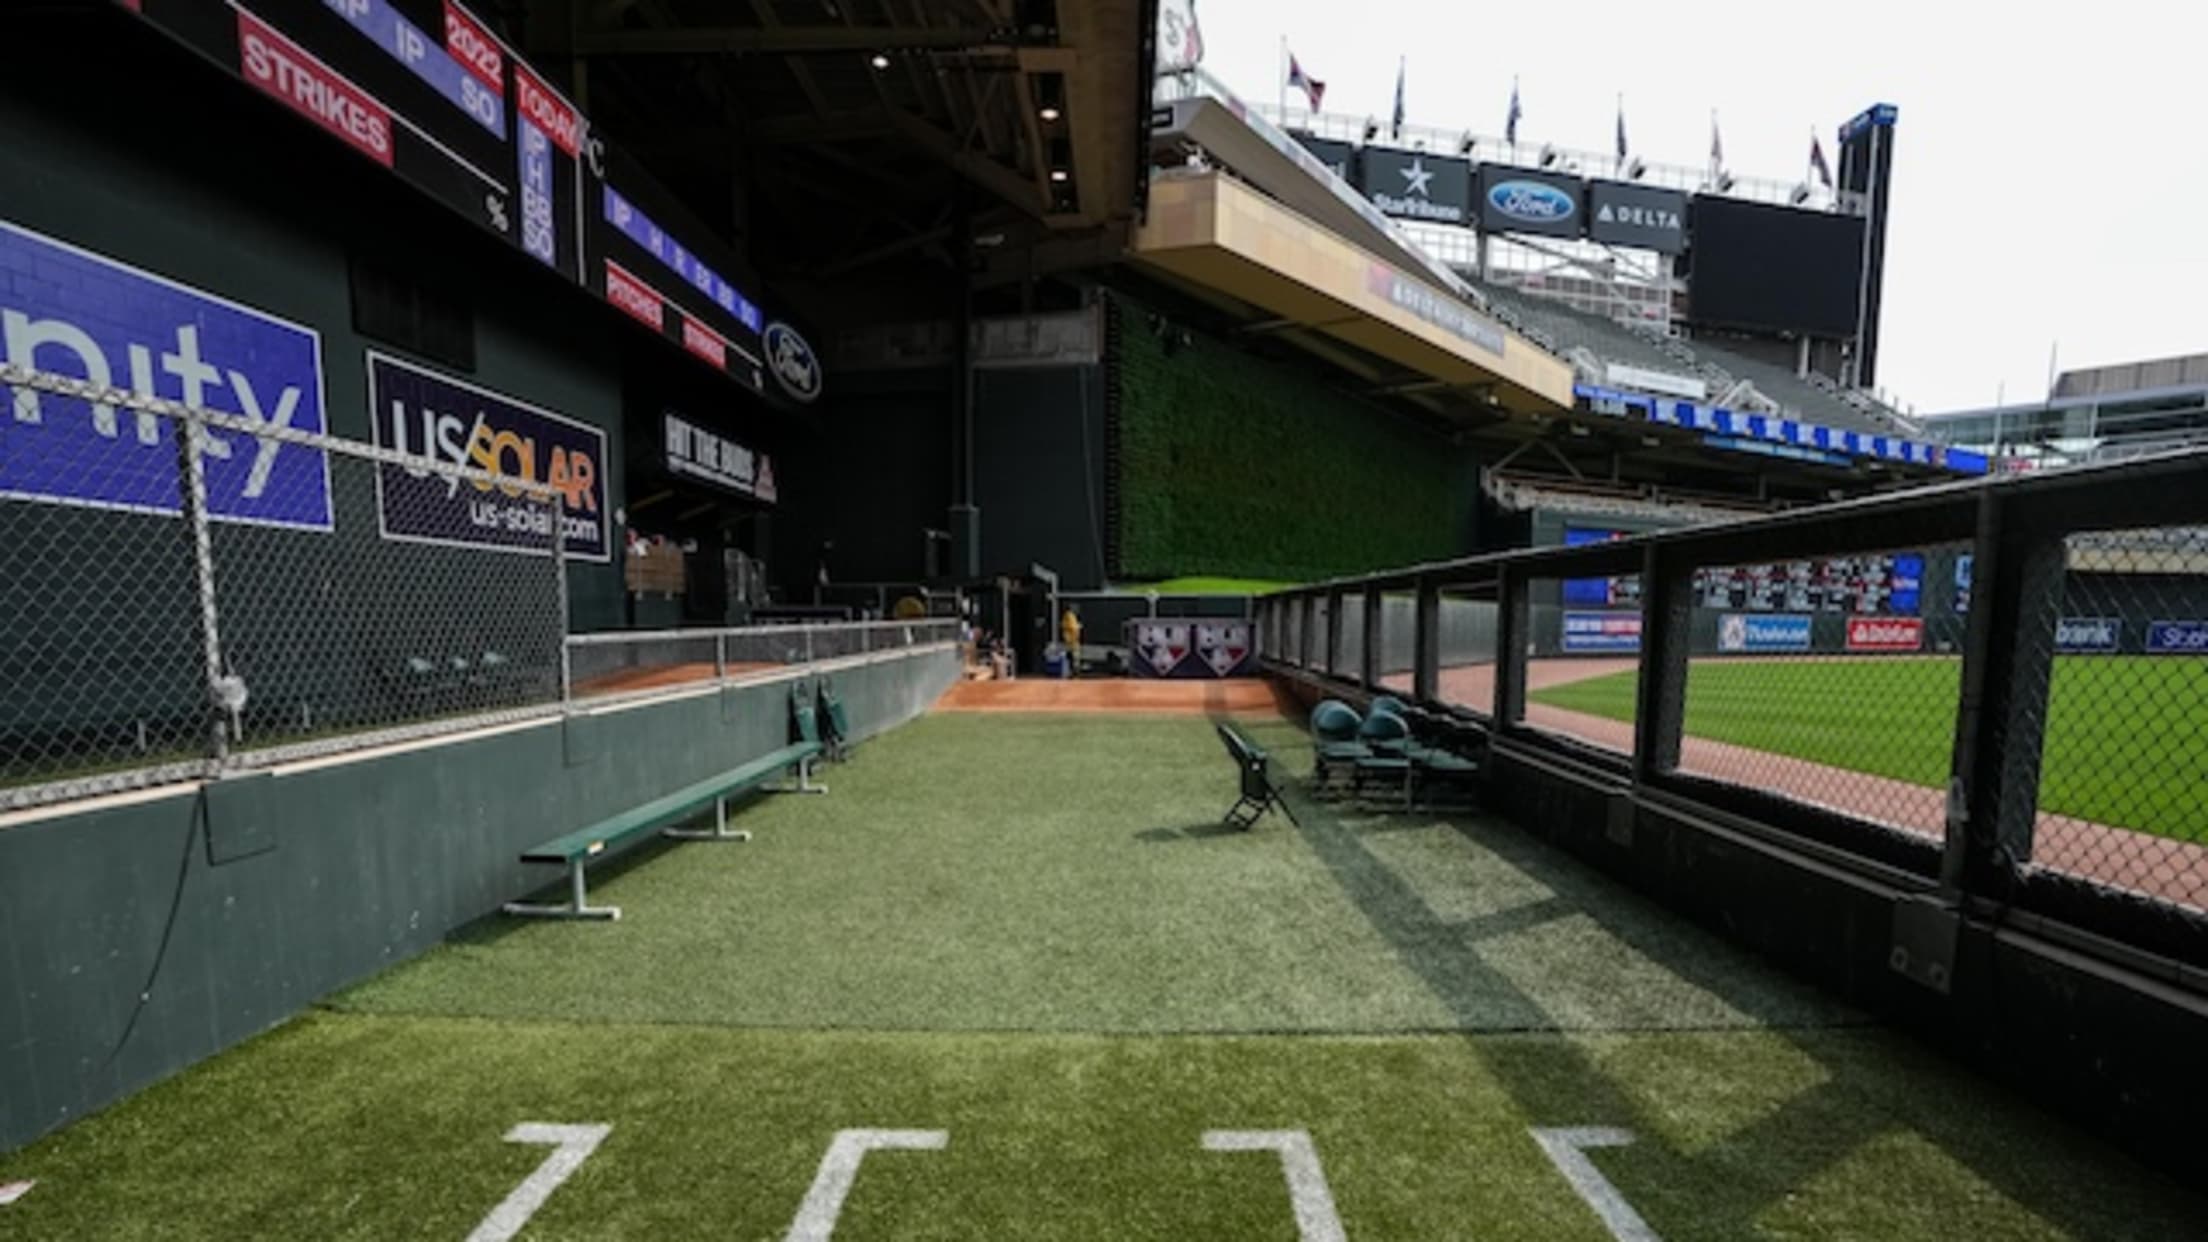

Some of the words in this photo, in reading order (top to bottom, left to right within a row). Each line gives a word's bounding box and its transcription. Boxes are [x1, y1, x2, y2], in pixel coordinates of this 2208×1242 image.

[396, 21, 425, 63] IP
[447, 14, 502, 84] 2022
[244, 35, 387, 152] STRIKES
[460, 75, 496, 127] SO
[1617, 206, 1681, 229] DELTA
